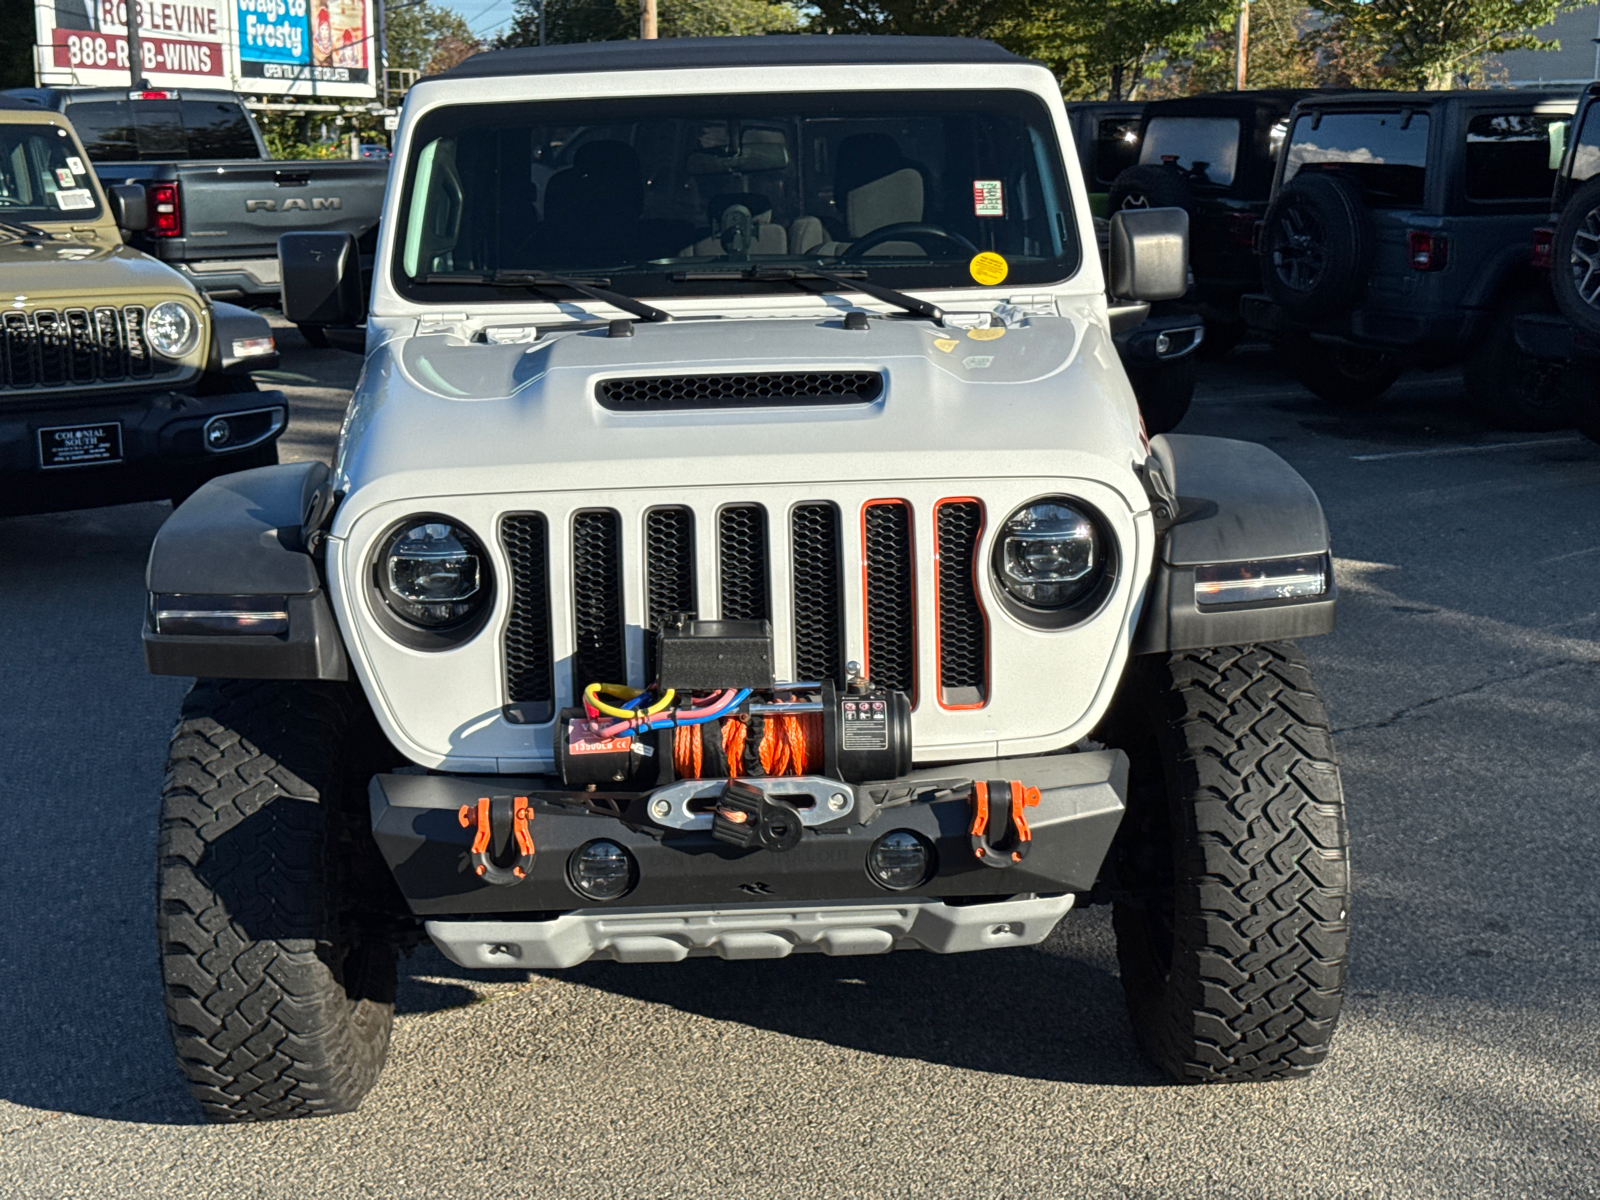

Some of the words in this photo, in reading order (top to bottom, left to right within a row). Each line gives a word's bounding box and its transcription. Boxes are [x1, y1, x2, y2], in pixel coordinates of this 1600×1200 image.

[150, 2, 217, 34] LEVINE
[246, 14, 303, 57] Frosty
[67, 35, 212, 72] 888-RB-WINS
[245, 197, 342, 213] RAM
[64, 437, 98, 447] SOUTH
